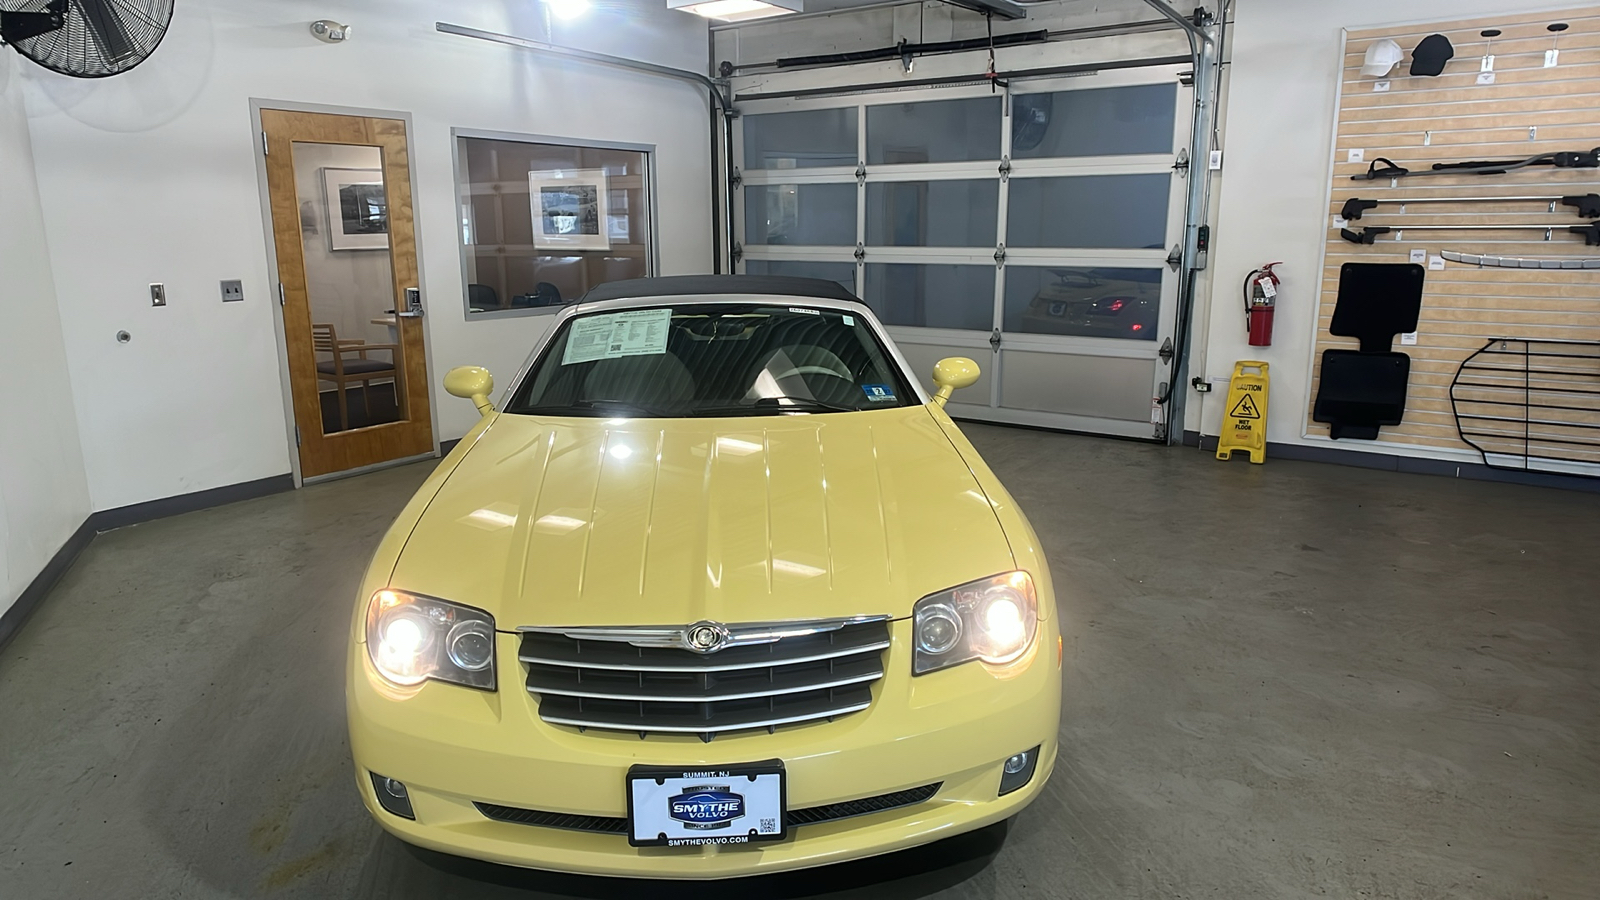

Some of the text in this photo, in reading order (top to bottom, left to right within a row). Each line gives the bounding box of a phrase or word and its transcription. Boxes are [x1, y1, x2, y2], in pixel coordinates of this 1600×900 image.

[1236, 384, 1262, 392] CAUTION
[719, 770, 730, 778] NJ
[673, 802, 739, 813] SMYTHE
[668, 836, 749, 847] SMYTHEVOLVO.COM
